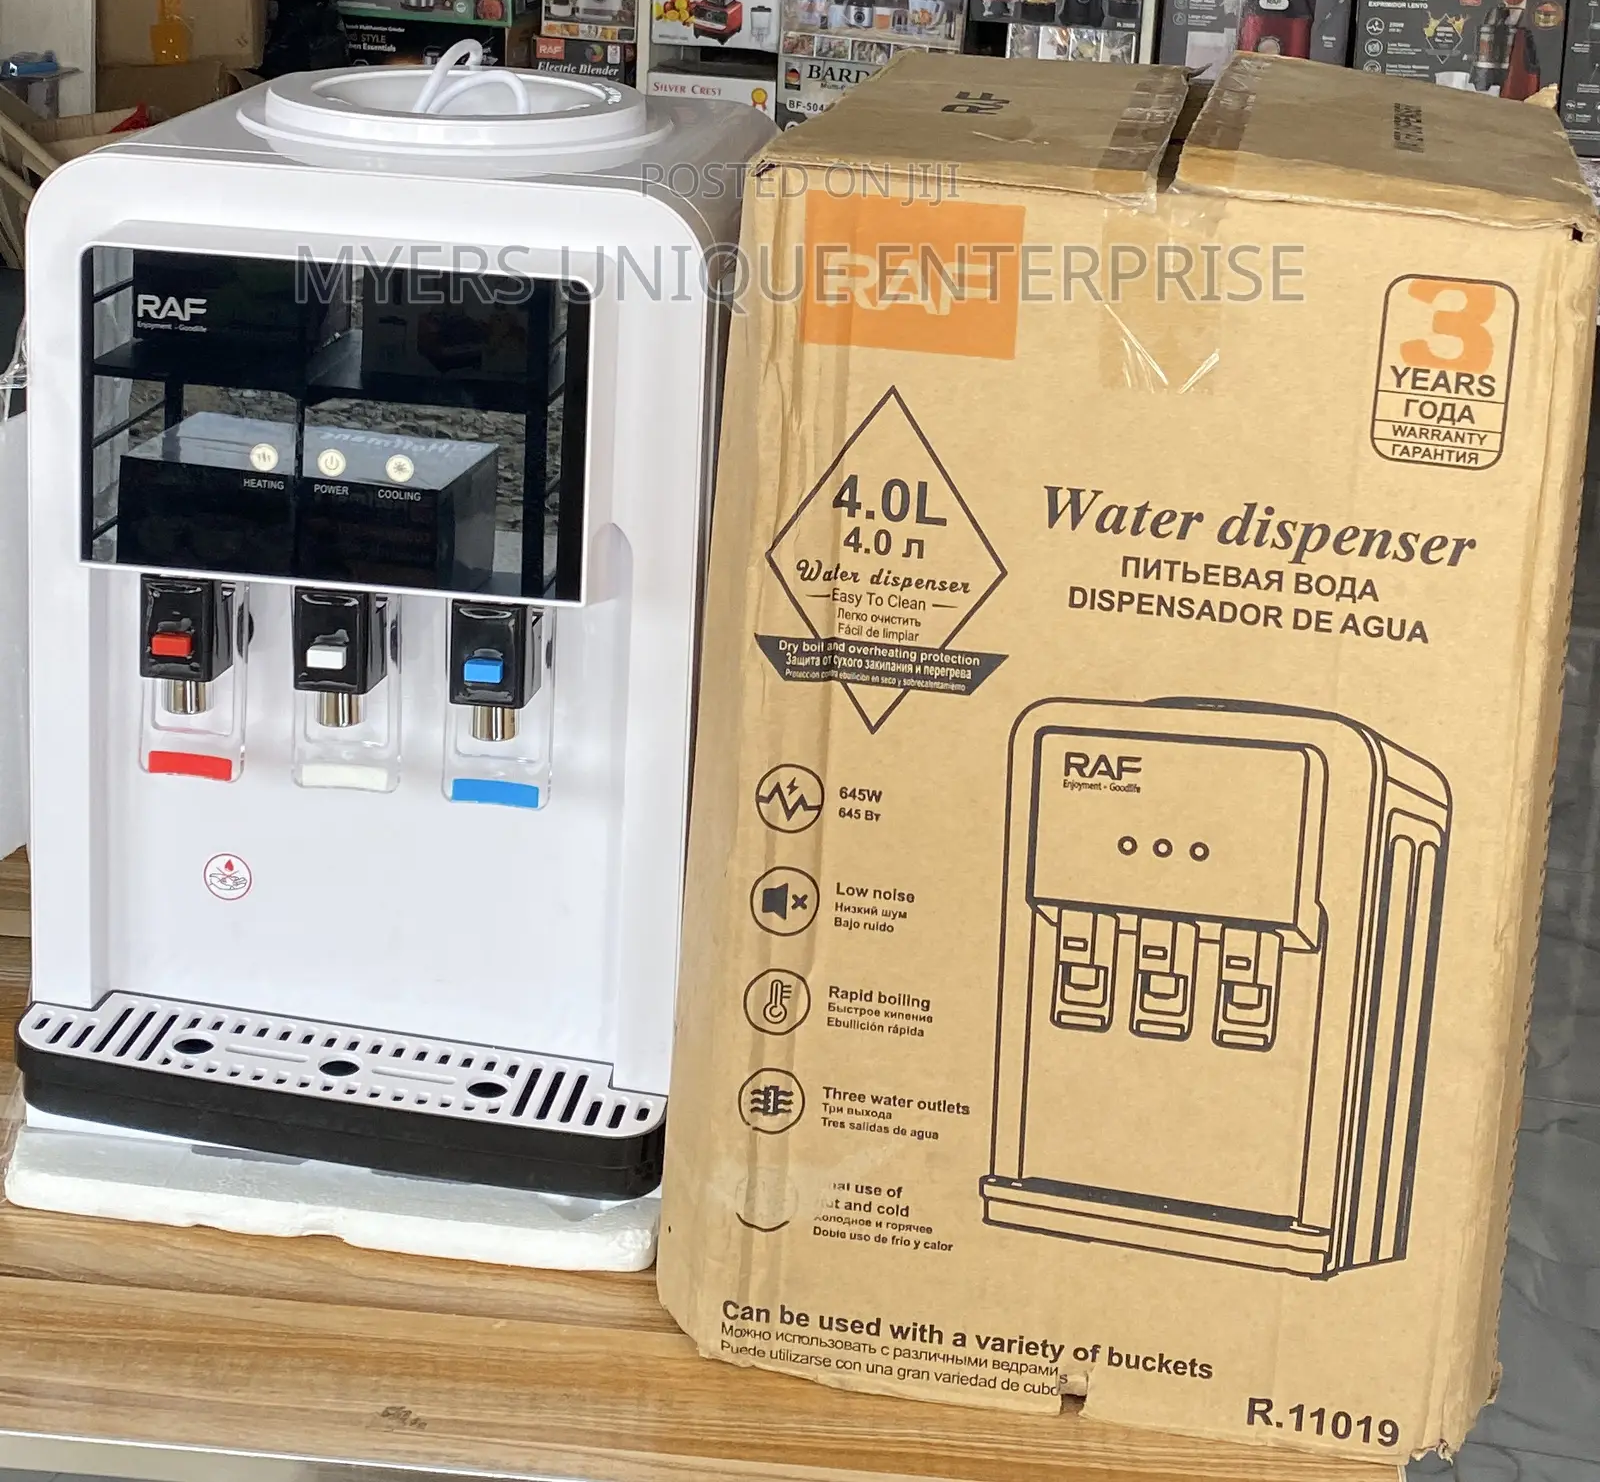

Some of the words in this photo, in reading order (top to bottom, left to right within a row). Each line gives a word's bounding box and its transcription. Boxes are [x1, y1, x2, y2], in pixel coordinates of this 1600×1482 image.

[538, 60, 576, 74] Electric
[579, 63, 619, 76] Blender
[653, 82, 686, 93] SILVER
[691, 84, 722, 96] CREST
[827, 251, 994, 316] RAF
[137, 294, 208, 322] RAF
[1400, 277, 1496, 370] 3
[1390, 365, 1496, 398] YEARS
[1403, 396, 1475, 427] ГОДА
[1391, 423, 1488, 447] WARRANTY
[1391, 443, 1479, 467] ГАРАНТИЯ
[243, 478, 285, 491] HEATING
[313, 483, 350, 497] POWER
[377, 488, 422, 502] COOLING
[832, 474, 947, 526] 4.0L
[1043, 484, 1204, 540] Water
[1217, 501, 1477, 567] dispenser
[843, 526, 892, 556] 4.0
[797, 559, 861, 584] Water
[870, 568, 971, 594] dispenser
[1121, 555, 1283, 593] ПИТЬЕВАЯ
[1293, 571, 1380, 604] ВОДА
[831, 588, 862, 607] Easy
[866, 592, 884, 607] To
[887, 595, 927, 611] Clean
[837, 608, 868, 623] Легко
[870, 612, 921, 628] очистить
[1068, 585, 1283, 629] DISPENSADOR
[1292, 607, 1332, 633] DE
[1340, 615, 1429, 644] AGUA
[778, 639, 799, 655] Dry
[802, 640, 824, 654] boil
[827, 641, 845, 654] and
[848, 643, 917, 663] overheating
[920, 650, 981, 666] protection
[1064, 750, 1142, 780] RAF
[839, 786, 882, 803] 645W
[838, 807, 861, 820] 645
[836, 882, 868, 898] Low
[873, 887, 915, 904] noise
[834, 902, 878, 916] Низкий
[882, 908, 908, 921] шум
[834, 916, 860, 931] Bajo
[863, 919, 894, 934] ruido
[829, 985, 873, 1005] Rapid
[878, 990, 931, 1012] boiling
[828, 1002, 880, 1018] Быстрое
[884, 1009, 933, 1024] кипение
[827, 1017, 884, 1034] Ebullición
[887, 1023, 924, 1038] rápida
[823, 1086, 866, 1104] Three
[870, 1092, 913, 1110] water
[917, 1098, 970, 1116] outlets
[821, 1117, 845, 1129] Tres
[849, 1121, 889, 1134] salidas
[893, 1125, 907, 1137] de
[910, 1129, 939, 1141] agua
[721, 1323, 772, 1342] Можно
[776, 1330, 877, 1355] использовать
[893, 1344, 988, 1369] различными
[992, 1358, 1060, 1379] ведрами
[722, 1300, 770, 1325] Can
[779, 1305, 810, 1328] be
[819, 1312, 882, 1337] used
[889, 1320, 944, 1346] with
[952, 1331, 967, 1348] a
[975, 1330, 1065, 1364] variety
[1072, 1344, 1101, 1364] of
[1107, 1346, 1214, 1381] buckets
[1246, 1397, 1399, 1447] R.11019
